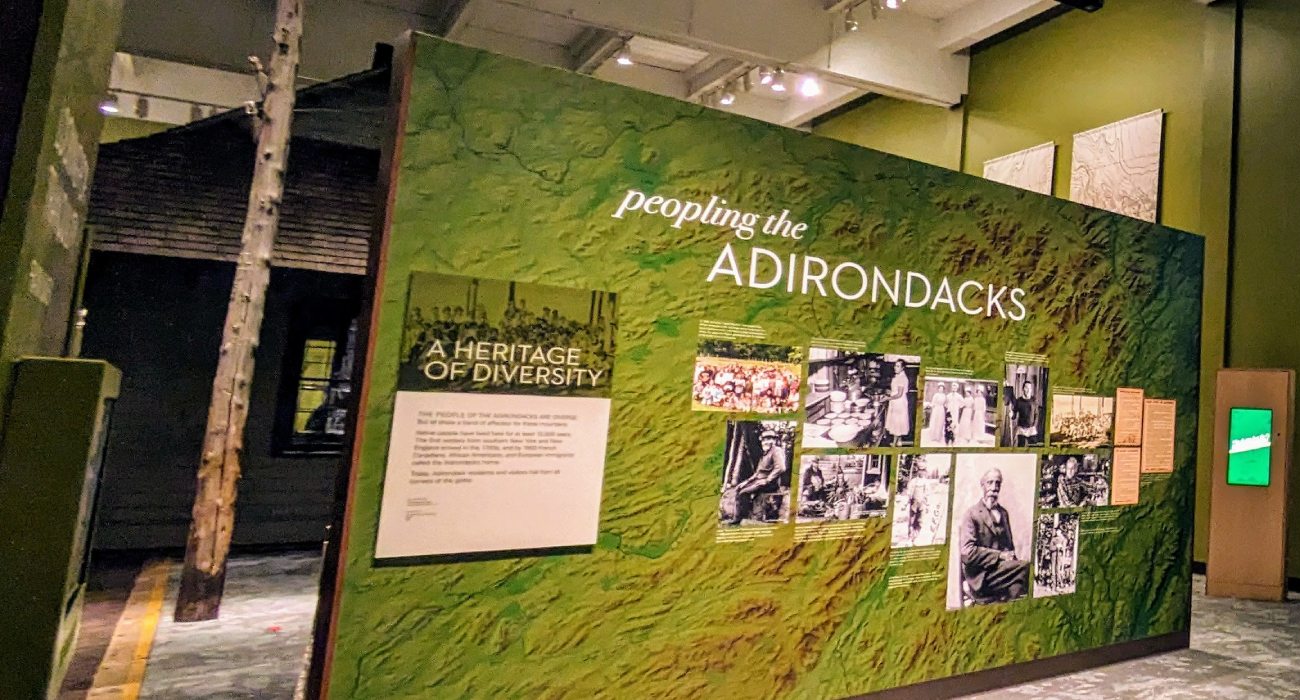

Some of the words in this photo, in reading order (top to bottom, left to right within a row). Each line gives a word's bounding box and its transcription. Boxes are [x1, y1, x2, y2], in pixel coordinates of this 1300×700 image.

[611, 188, 759, 240] peopling
[762, 209, 808, 240] the
[706, 242, 1027, 321] ADIRONDACKS
[427, 340, 446, 358] A
[455, 341, 581, 366] HERITAGE
[424, 361, 466, 380] OF
[473, 363, 603, 386] DIVERSITY
